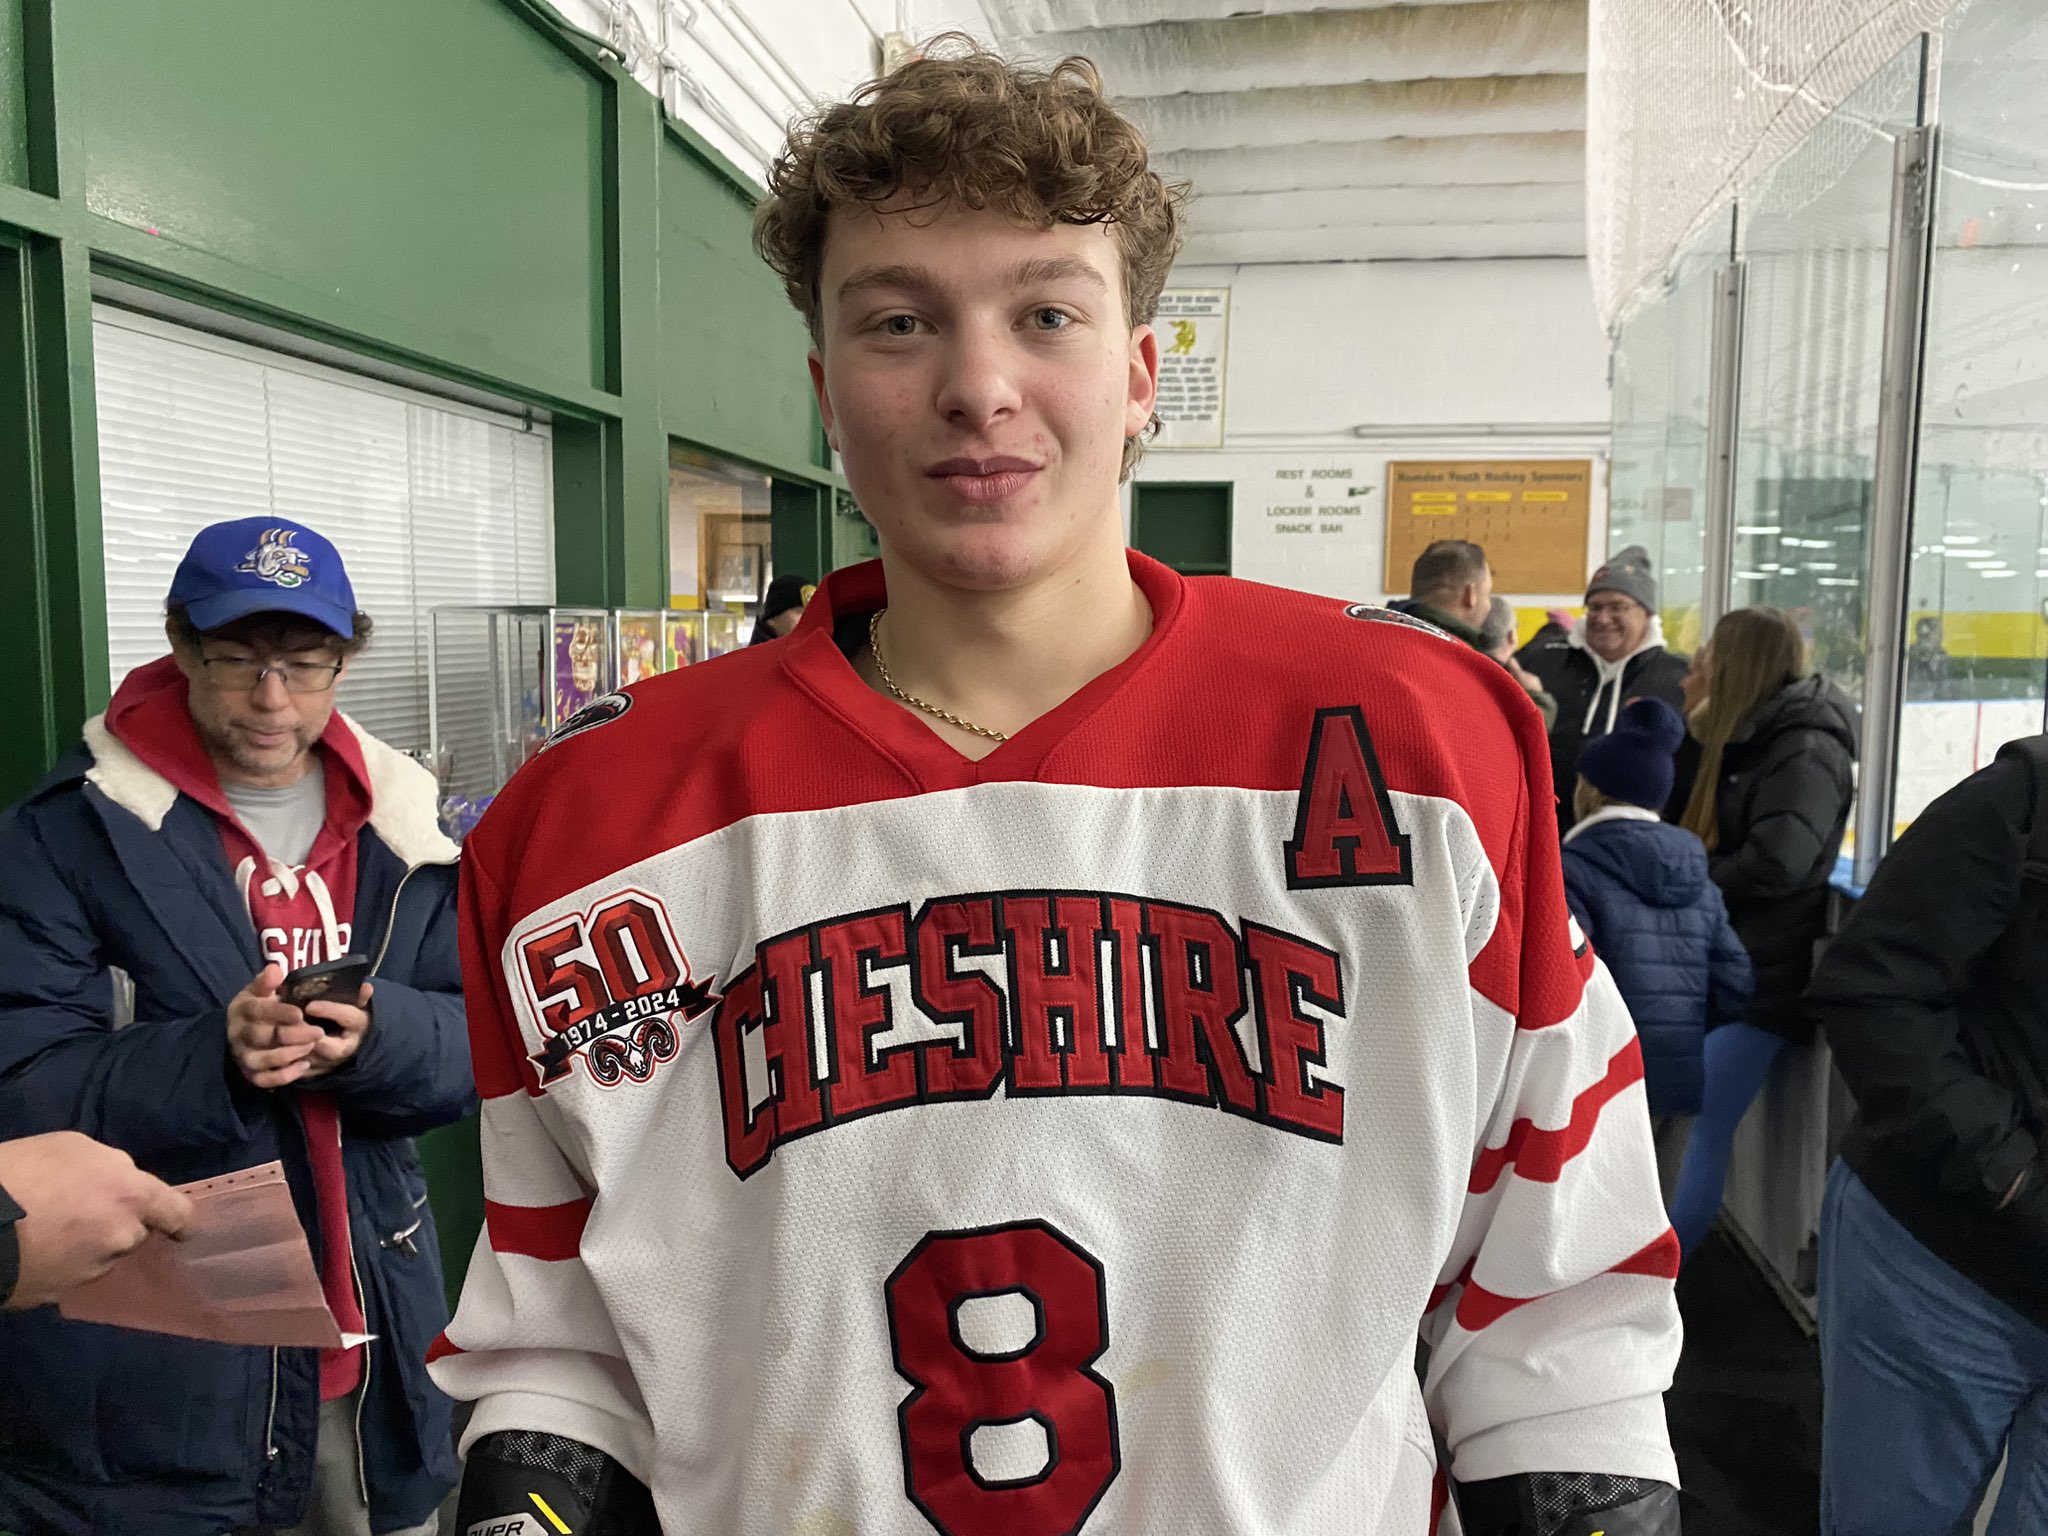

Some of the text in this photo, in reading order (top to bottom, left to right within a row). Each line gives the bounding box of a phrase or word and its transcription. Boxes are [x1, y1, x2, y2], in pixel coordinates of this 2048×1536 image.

[1266, 505, 1361, 517] LOCKER ROOMS
[1276, 468, 1352, 479] REST ROOMS
[1305, 485, 1313, 498] &
[1275, 523, 1343, 534] SNACK BAR
[1283, 704, 1414, 890] A
[521, 897, 682, 1034] 50
[711, 888, 1347, 1182] CHESHIRE
[884, 1217, 1122, 1536] 8
